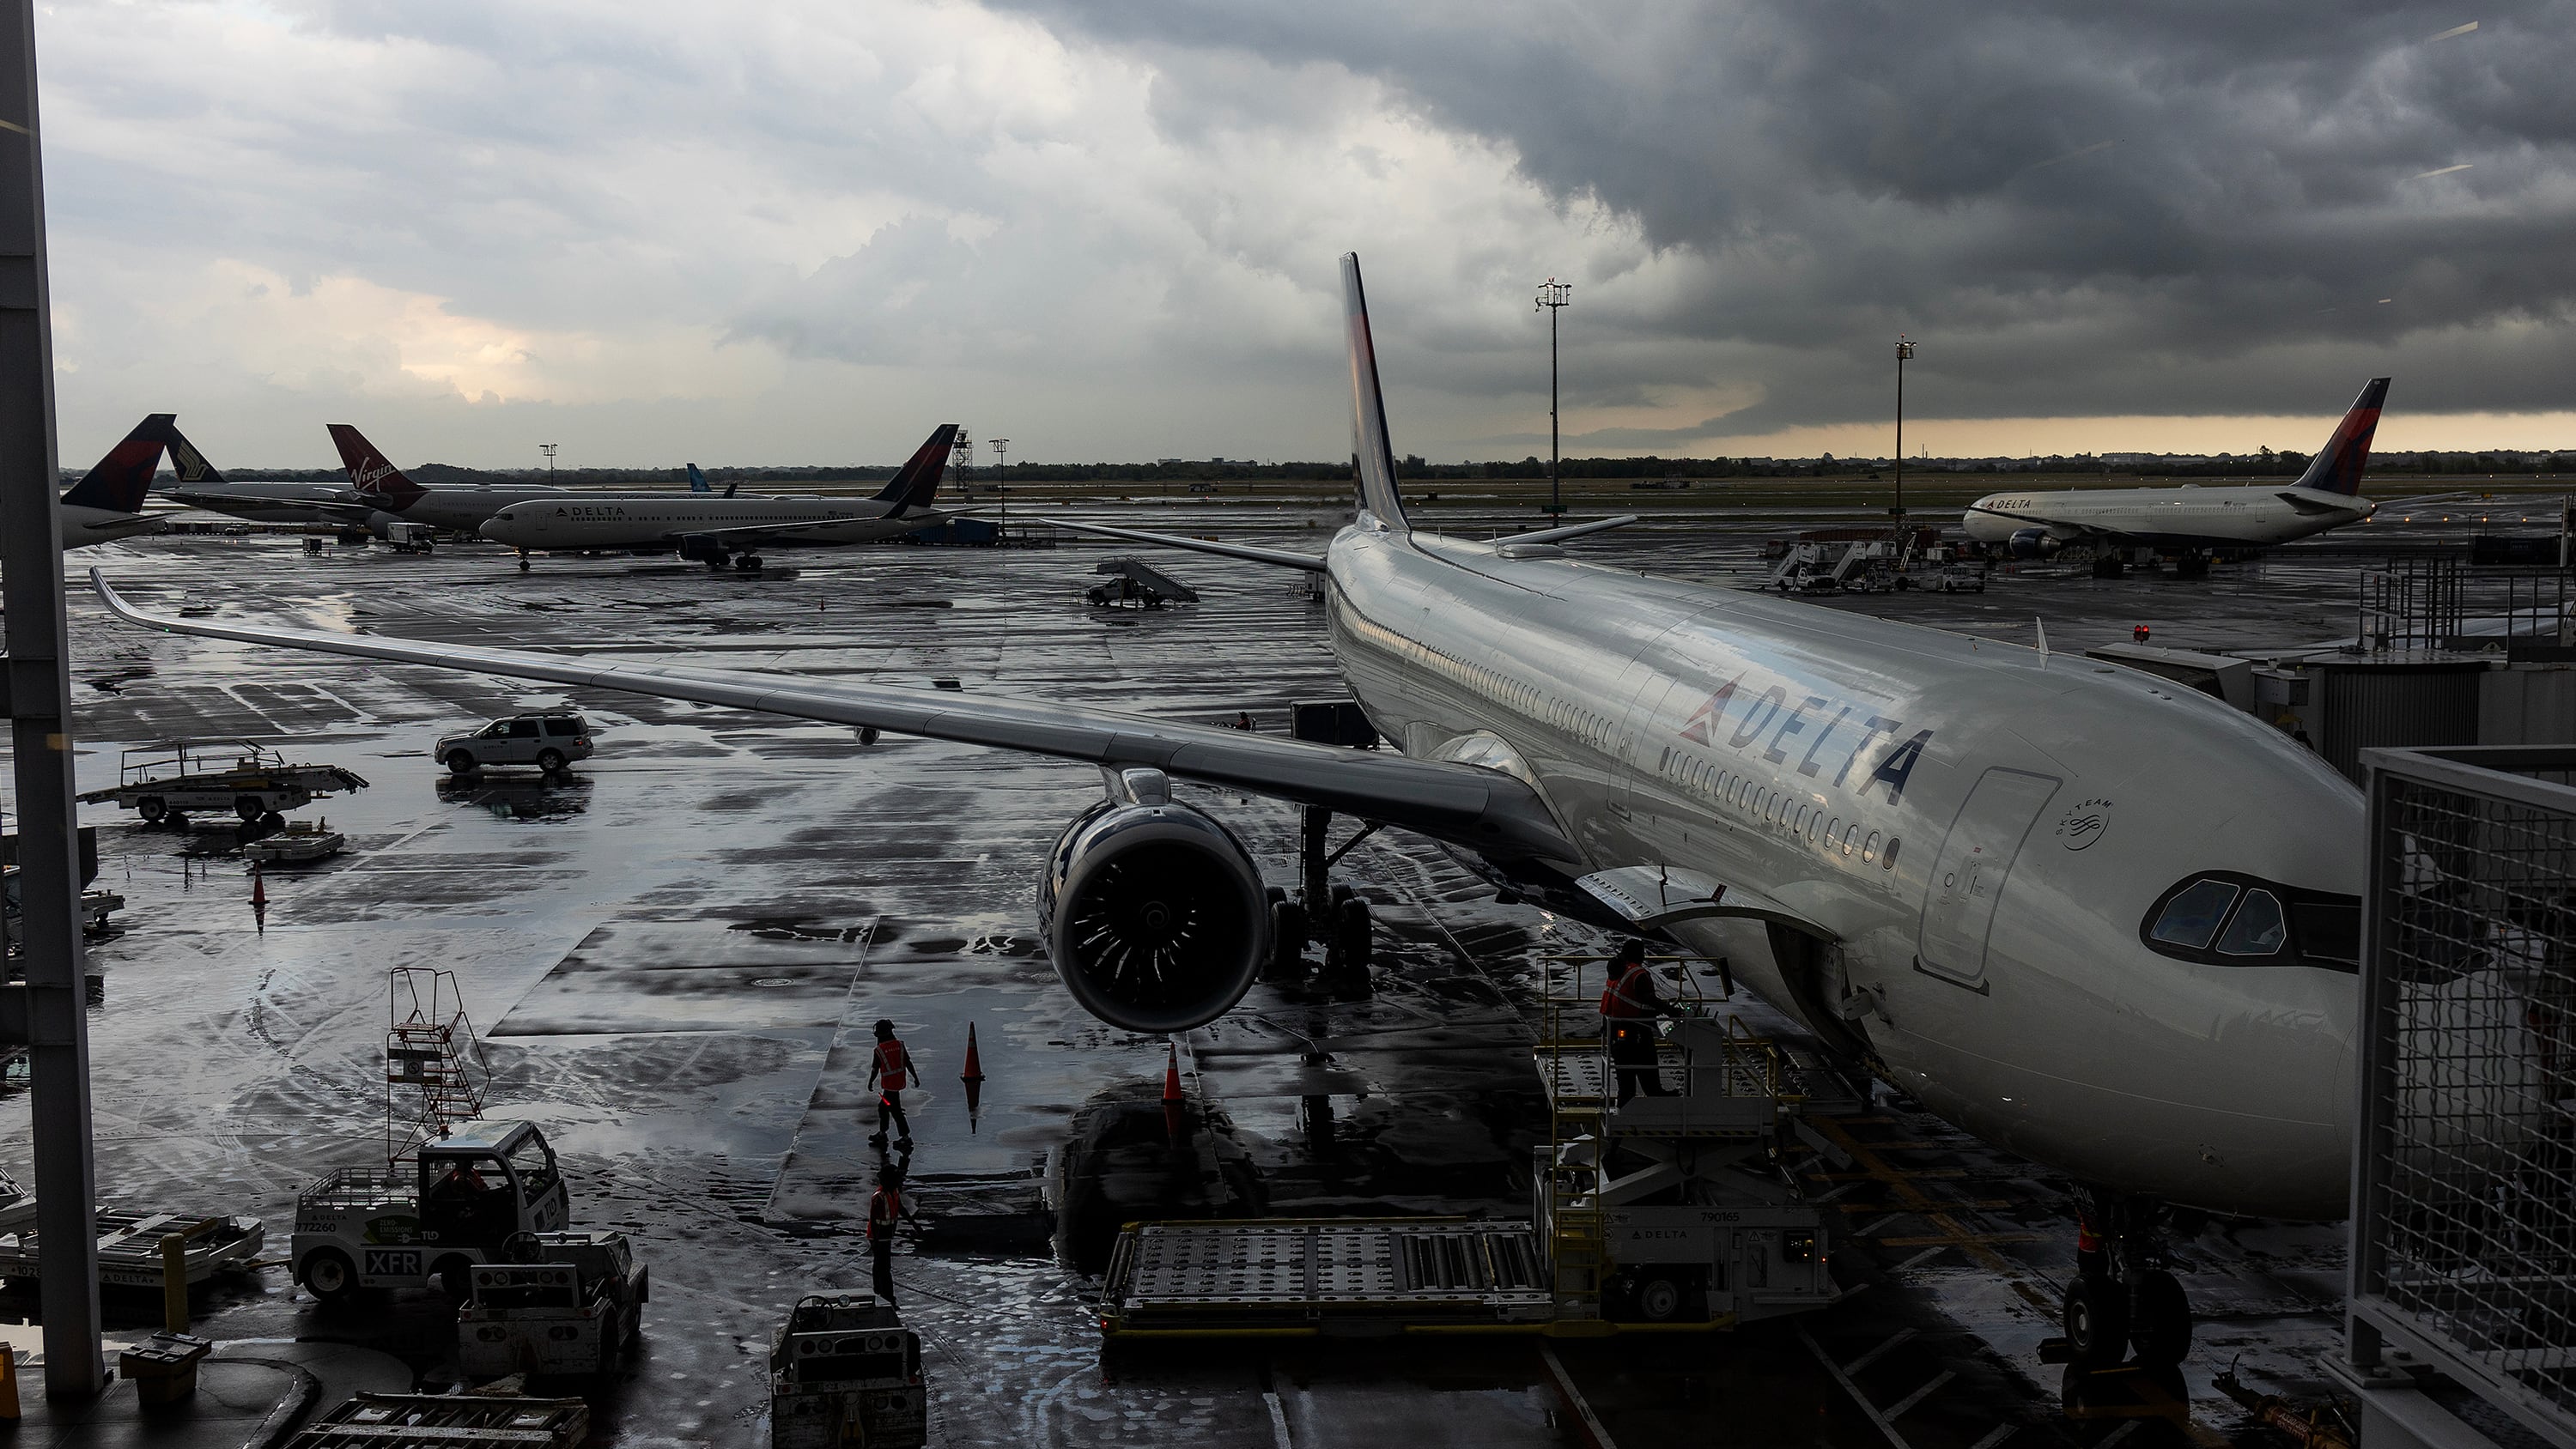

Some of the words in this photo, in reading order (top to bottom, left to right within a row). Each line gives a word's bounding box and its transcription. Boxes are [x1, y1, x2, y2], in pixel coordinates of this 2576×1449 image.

[350, 457, 397, 492] Virgin
[1997, 500, 2031, 508] DELTA
[572, 506, 625, 516] DELTA
[1728, 684, 1935, 807] DELTA
[1700, 1212, 1740, 1222] 790165
[295, 1222, 336, 1233] 772260
[421, 1230, 440, 1241] TLD
[1645, 1231, 1687, 1240] DELTA
[369, 1252, 419, 1275] XFR
[113, 1274, 149, 1284] DELTA
